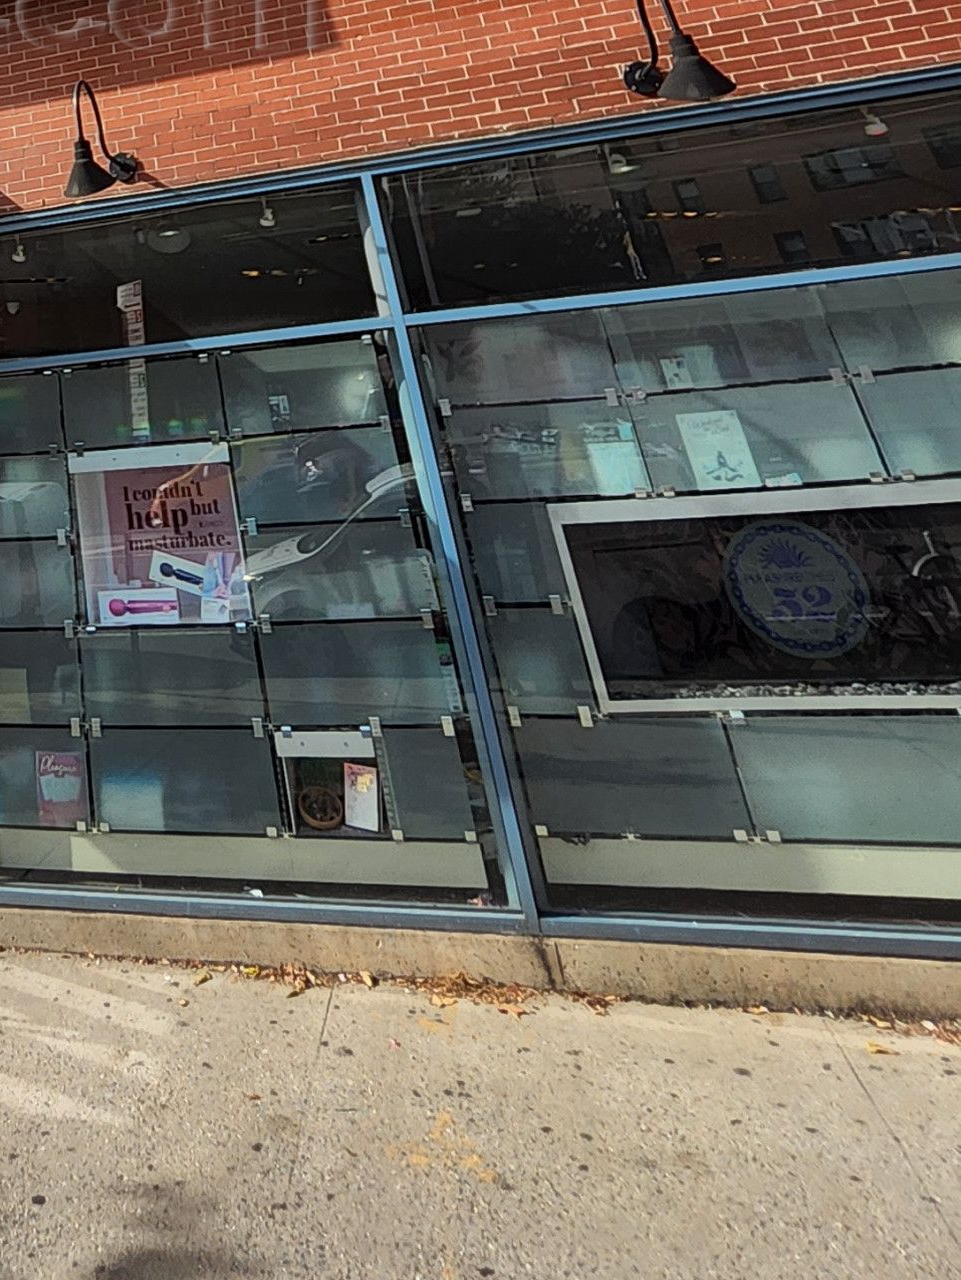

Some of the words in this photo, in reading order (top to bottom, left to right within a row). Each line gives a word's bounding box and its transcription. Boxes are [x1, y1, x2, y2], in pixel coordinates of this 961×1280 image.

[123, 486, 130, 501] I
[125, 501, 189, 535] help
[189, 498, 221, 516] but
[128, 531, 232, 551] masturbate.
